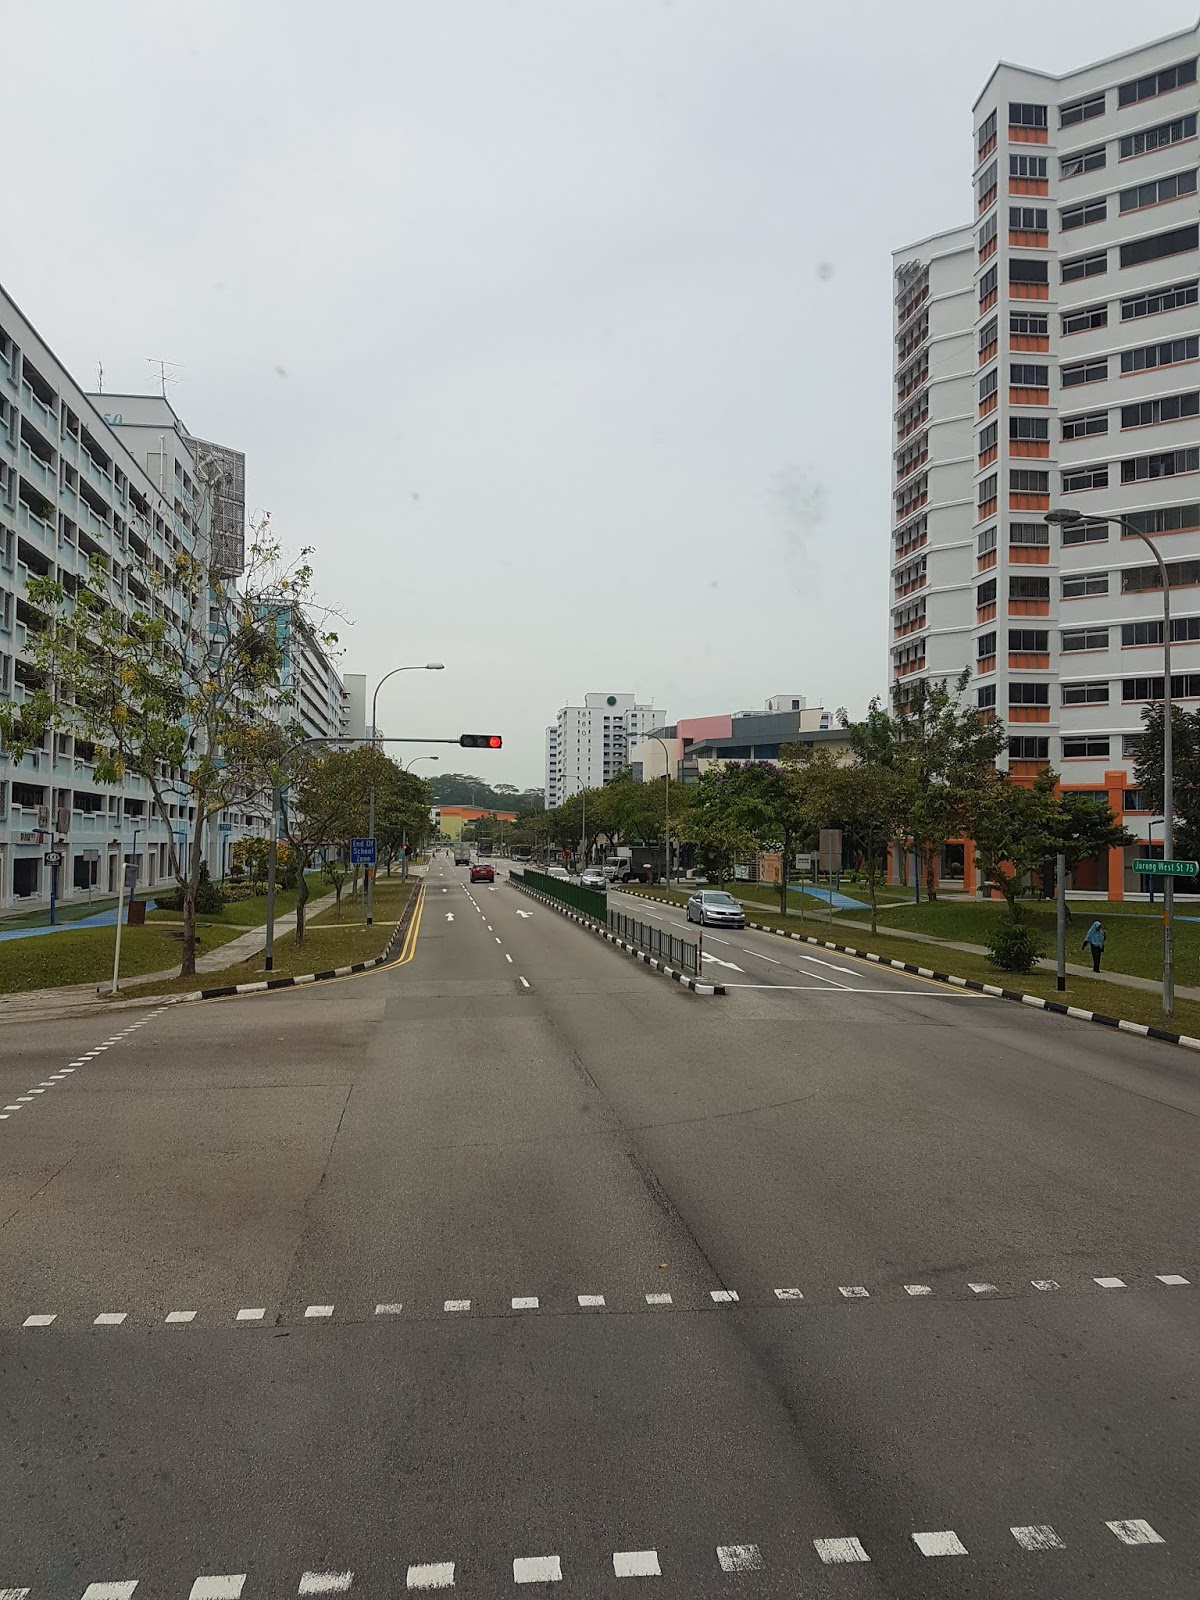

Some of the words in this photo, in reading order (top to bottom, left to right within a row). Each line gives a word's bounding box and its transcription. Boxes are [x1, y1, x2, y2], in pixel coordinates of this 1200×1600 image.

[1135, 861, 1156, 872] Jurong
[1158, 862, 1174, 871] West
[1176, 863, 1183, 872] St
[1186, 864, 1194, 873] 75
